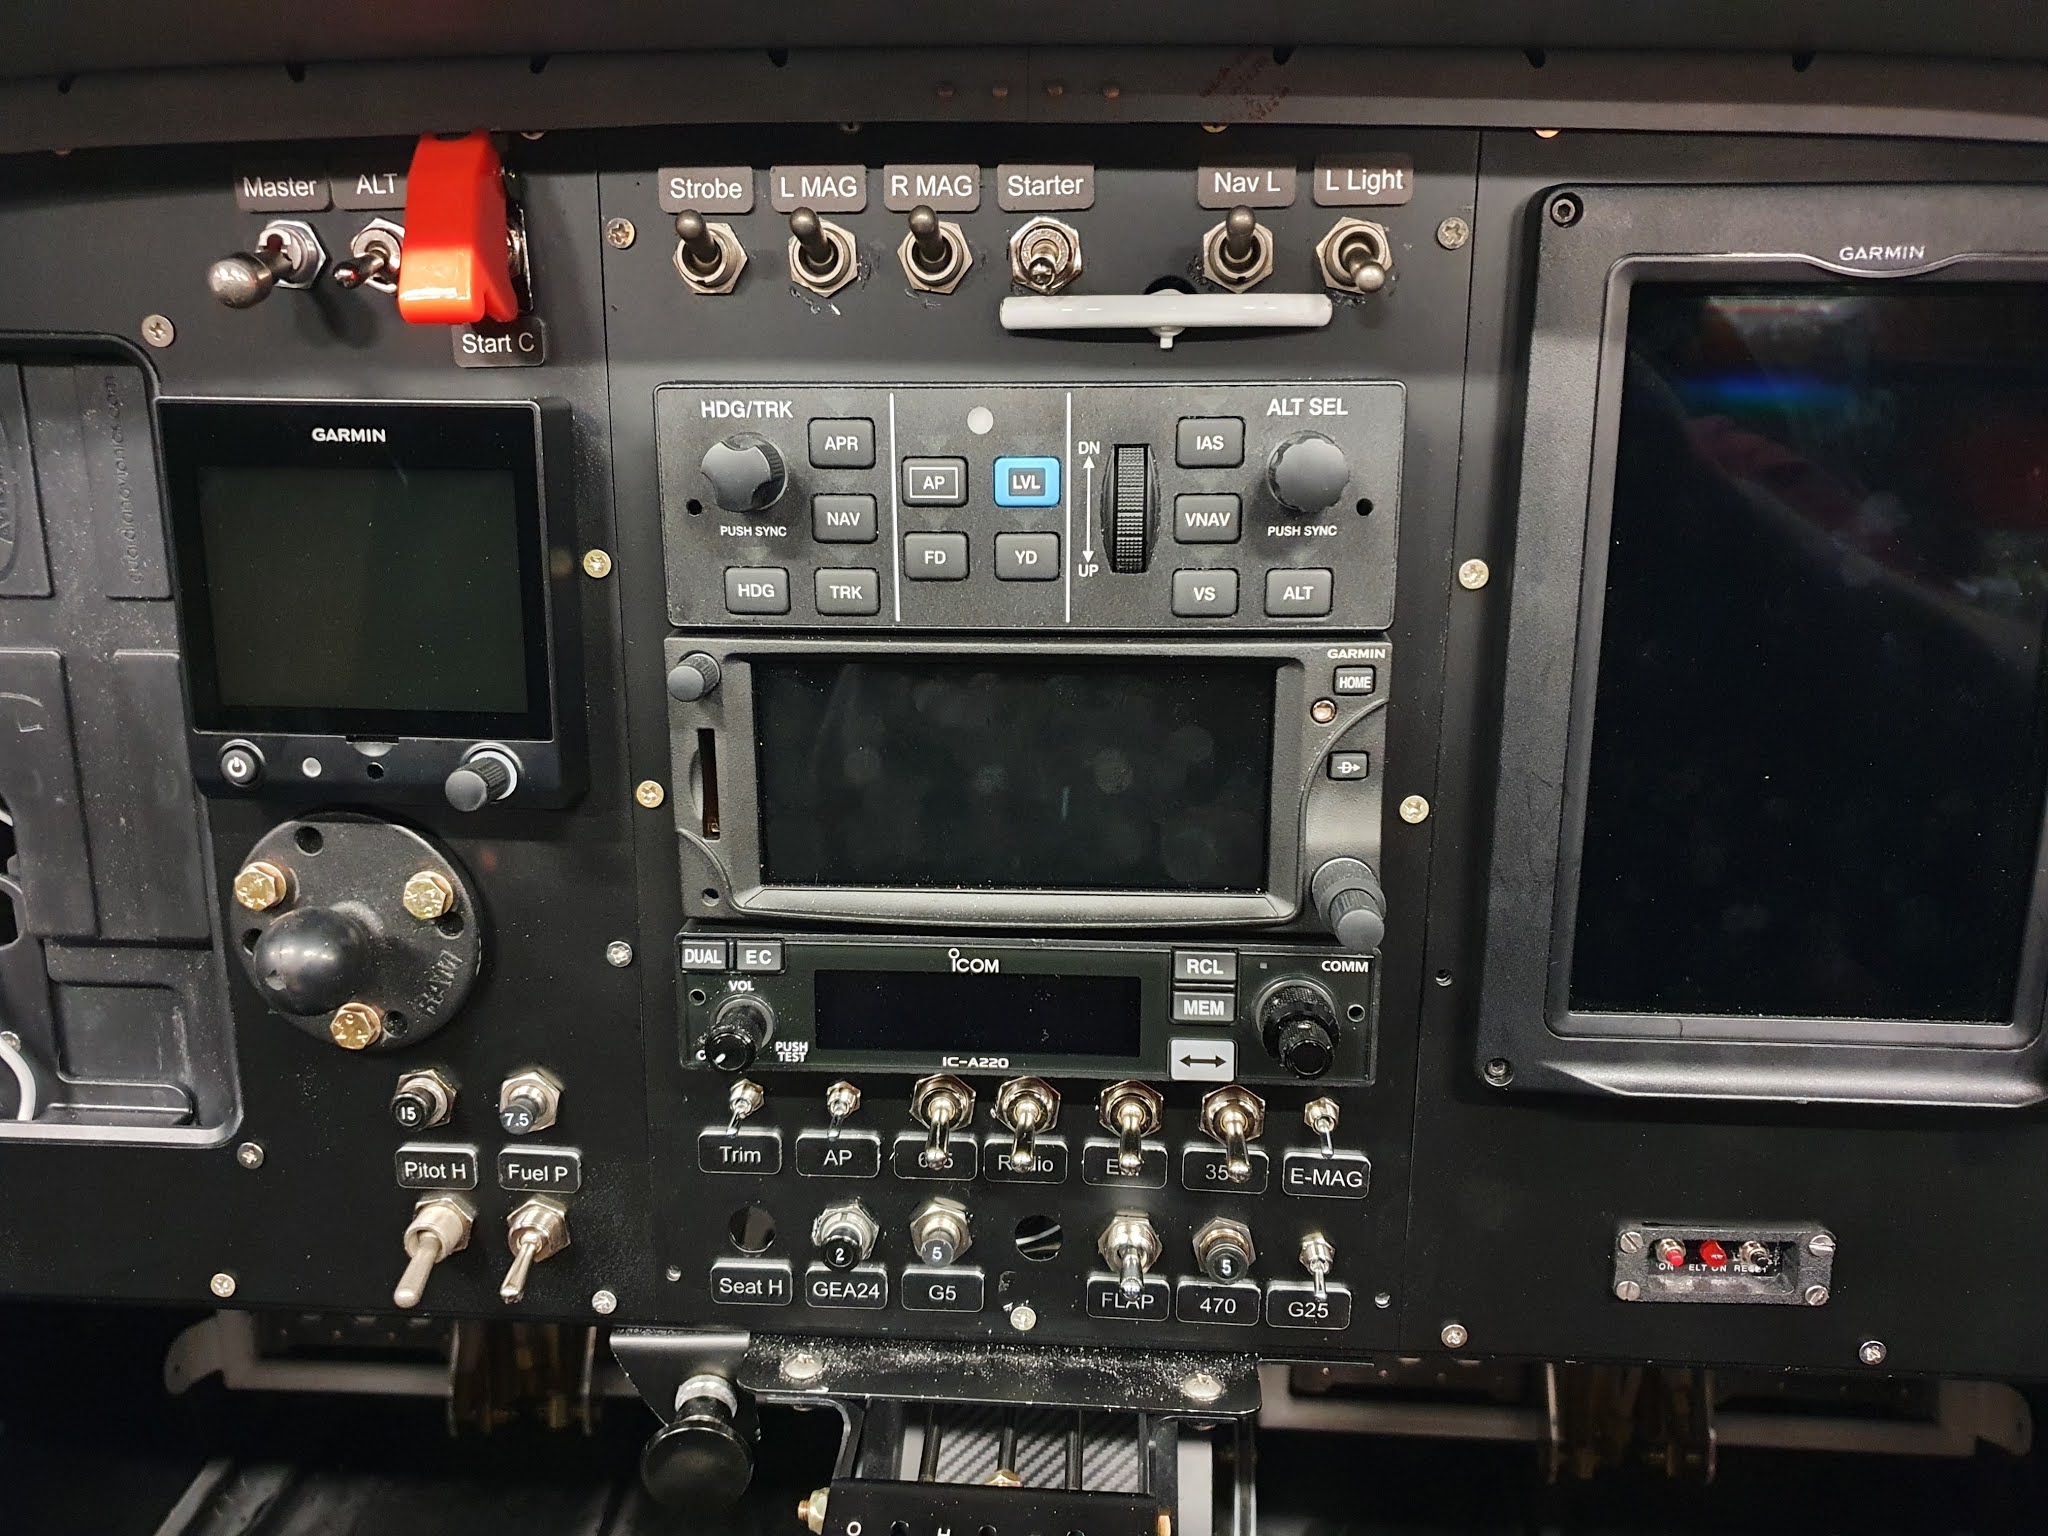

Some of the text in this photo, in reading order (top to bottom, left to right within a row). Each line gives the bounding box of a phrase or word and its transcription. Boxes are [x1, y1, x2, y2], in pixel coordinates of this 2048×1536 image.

[243, 176, 317, 198] Master
[356, 173, 398, 194] ALT
[670, 177, 743, 199] Strobe
[781, 176, 857, 197] L MAG
[891, 175, 973, 196] R MAG
[1007, 175, 1084, 196] Starter
[1214, 172, 1280, 194] Nav L
[1326, 169, 1404, 194] L Light
[1838, 245, 1925, 261] GARMIN
[462, 333, 535, 353] Start C
[701, 400, 794, 419] HDG/TRK
[1266, 398, 1349, 416] ALT SEL
[311, 427, 387, 443] GARMIN
[824, 436, 859, 452] APR
[1078, 441, 1101, 455] DN
[1196, 436, 1225, 451] IAS
[923, 476, 946, 490] AP
[1012, 475, 1041, 490] LVL
[826, 512, 860, 527] NAV
[1184, 513, 1231, 527] VNAV
[720, 526, 788, 538] PUSH SYNC
[1267, 525, 1338, 537] PUSH SYNC
[924, 551, 947, 565] FD
[1015, 551, 1039, 565] YD
[1078, 564, 1099, 578] UP
[738, 584, 775, 599] HDG
[830, 586, 863, 600] TRK
[1193, 587, 1216, 601] VS
[1283, 586, 1314, 600] ALT
[1327, 648, 1386, 659] GARMIN
[1339, 676, 1372, 689] HOME
[684, 949, 722, 964] DUAL
[1186, 959, 1224, 975] RCL
[1321, 960, 1369, 973] COMM
[728, 980, 754, 991] VOL
[1183, 1000, 1225, 1015] MEM
[775, 1041, 809, 1052] PUSH
[777, 1052, 807, 1062] TEST
[942, 1056, 1009, 1068] IC-A220
[401, 1107, 416, 1121] 15
[504, 1112, 529, 1127] 7.5
[719, 1146, 761, 1163] Trim
[823, 1150, 853, 1165] AP
[918, 1151, 954, 1169] 65
[404, 1161, 467, 1180] Pitot H
[508, 1164, 568, 1182] Fuel P
[1290, 1170, 1363, 1188] E-MAG
[835, 1248, 845, 1262] 2
[932, 1247, 942, 1260] 5
[1221, 1259, 1231, 1275] 5
[1658, 1262, 1674, 1271] ON
[1688, 1263, 1707, 1272] ELT
[719, 1277, 783, 1296] Seat H
[813, 1282, 880, 1299] GEA24
[928, 1284, 956, 1301] G5
[1102, 1291, 1155, 1310] FLAP
[1199, 1297, 1236, 1314] 470
[1288, 1302, 1329, 1318] G25
